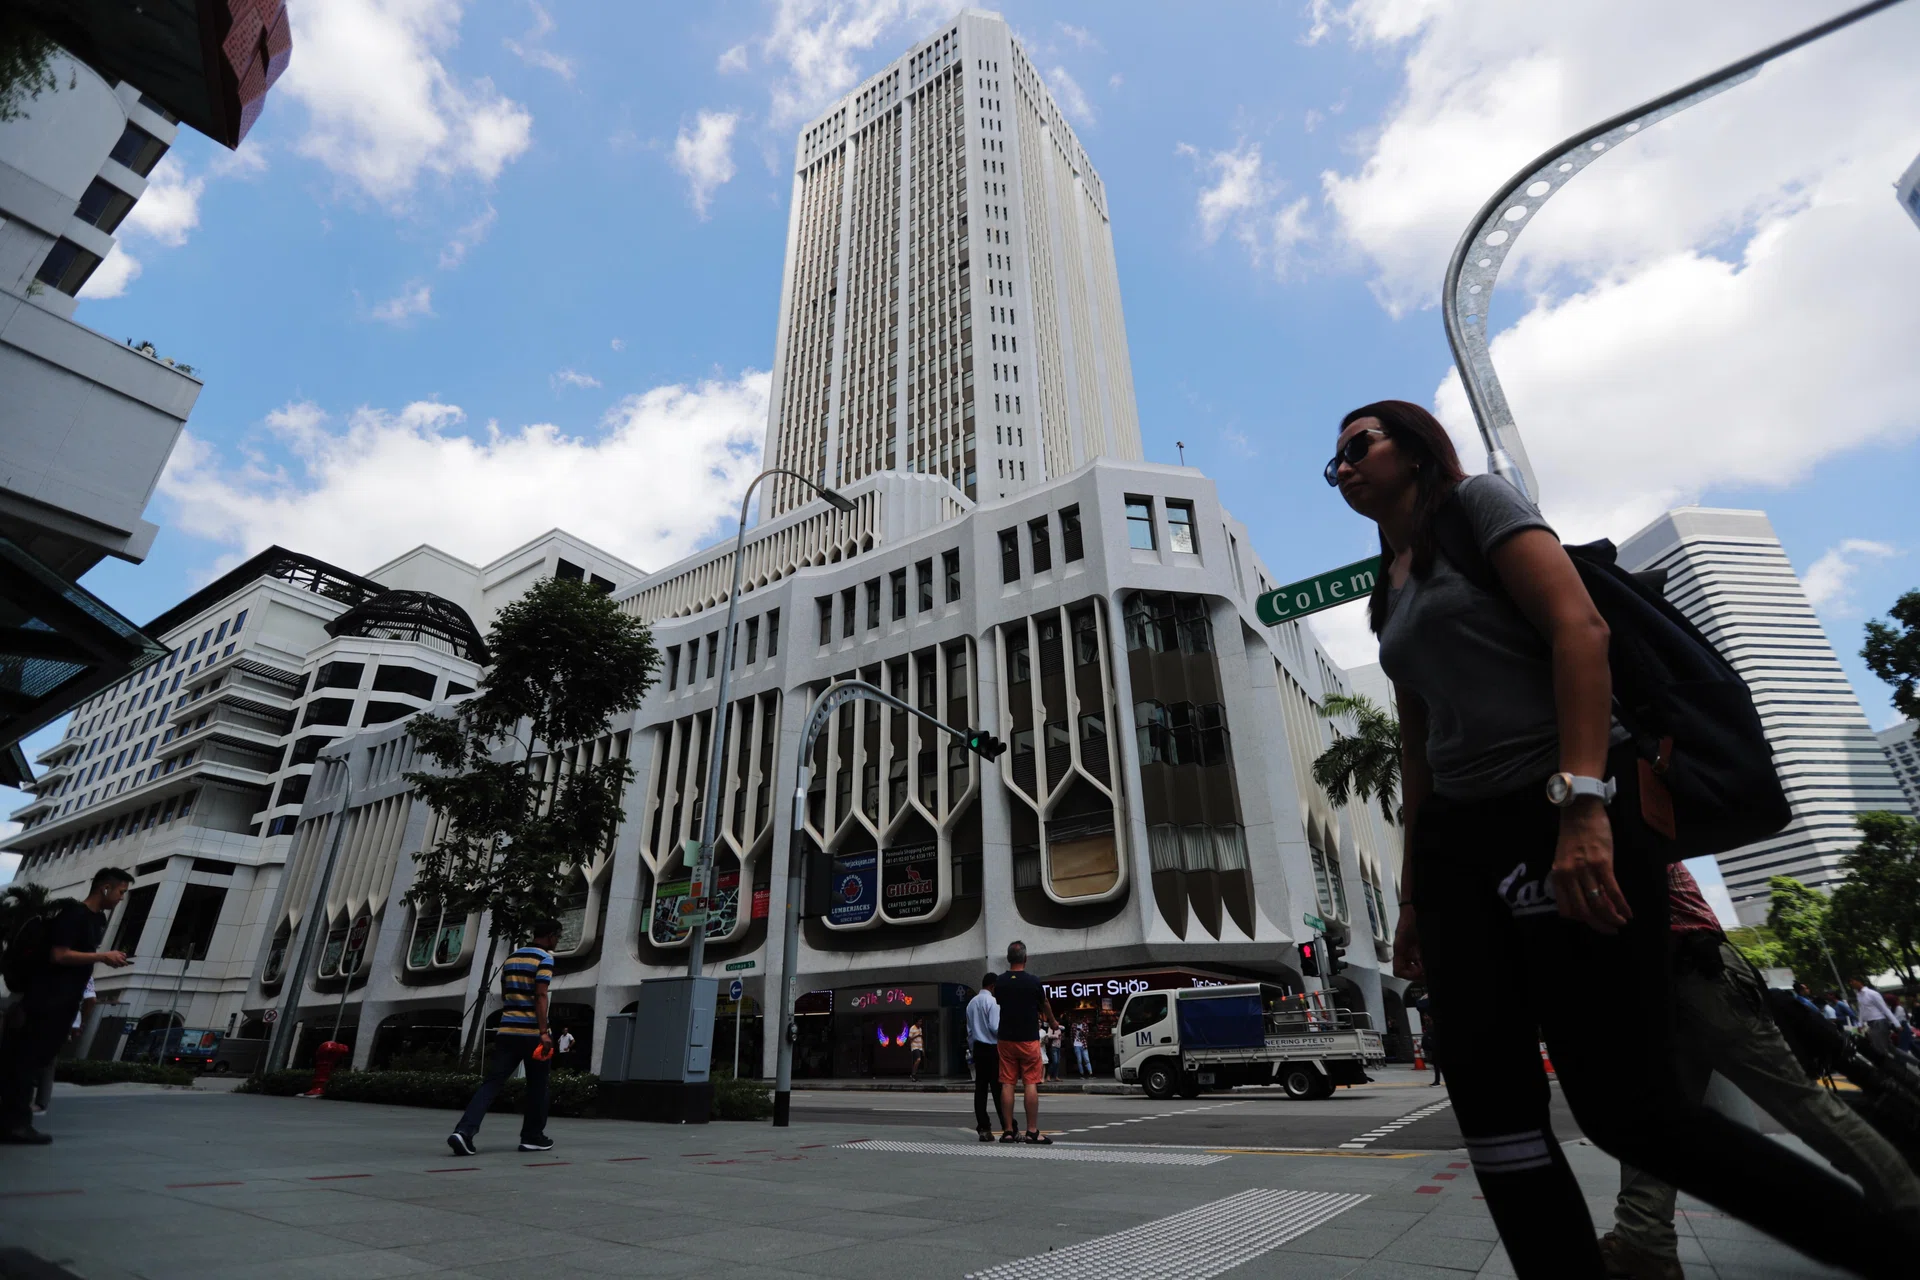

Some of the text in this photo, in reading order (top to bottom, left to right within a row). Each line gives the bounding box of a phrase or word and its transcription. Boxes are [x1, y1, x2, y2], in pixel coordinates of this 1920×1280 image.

[1272, 570, 1375, 616] Colem
[831, 904, 870, 914] LUMBERJACKS
[887, 901, 907, 909] CRAFTED
[919, 897, 933, 905] PRIDE
[727, 962, 746, 971] Coleman
[1042, 979, 1149, 999] THE GIFT SHOP
